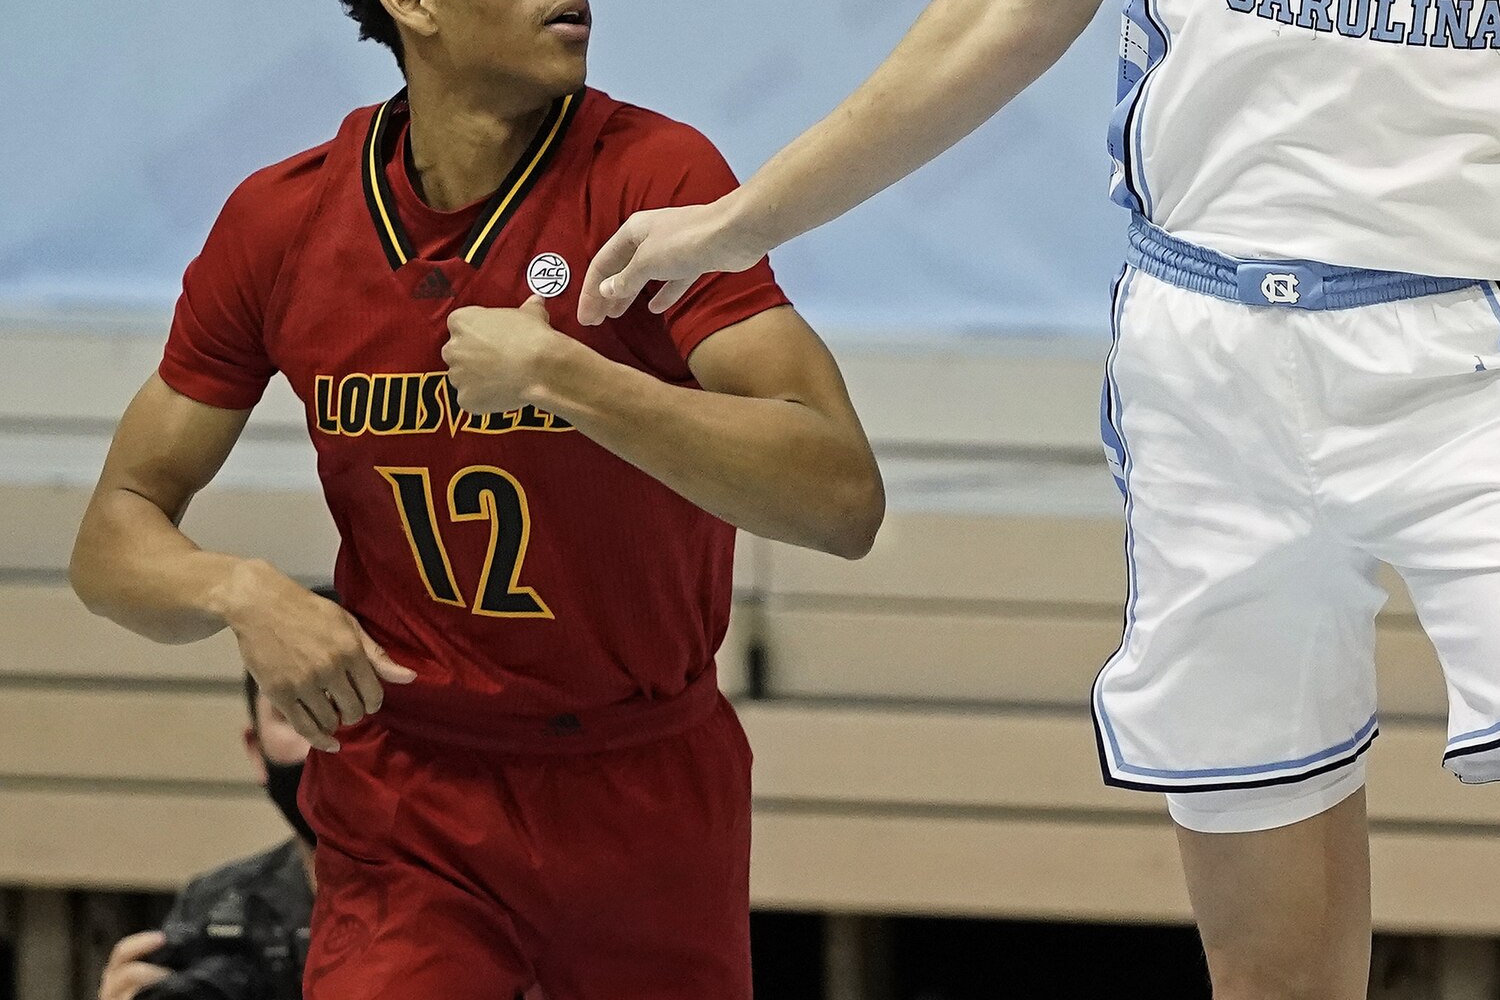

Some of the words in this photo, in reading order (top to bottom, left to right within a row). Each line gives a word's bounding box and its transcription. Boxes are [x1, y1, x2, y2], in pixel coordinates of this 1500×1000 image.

[534, 267, 566, 278] ACC
[314, 371, 578, 438] LOUISV
[372, 463, 556, 620] 12
